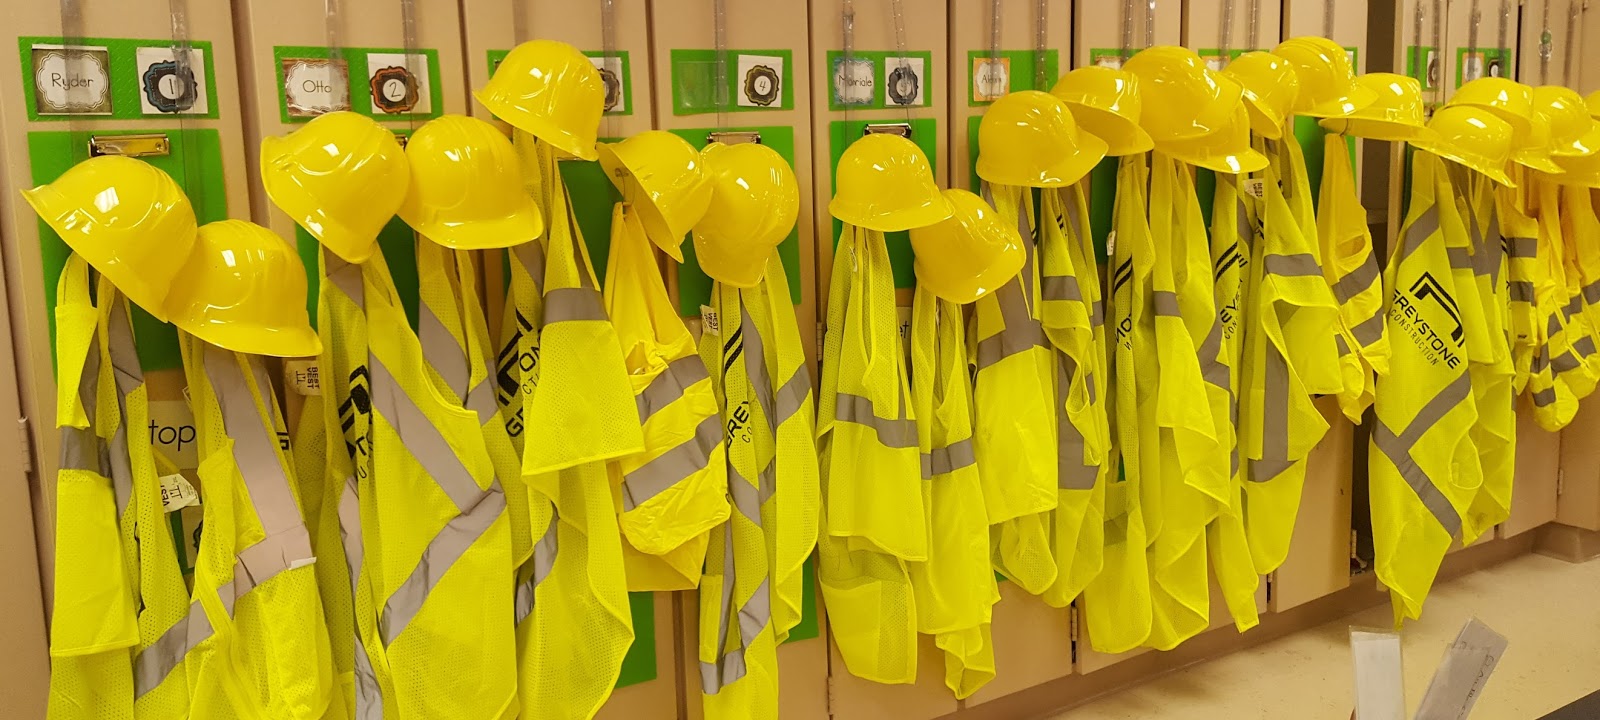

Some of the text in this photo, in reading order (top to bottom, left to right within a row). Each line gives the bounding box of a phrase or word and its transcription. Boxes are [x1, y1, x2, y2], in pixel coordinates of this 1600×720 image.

[51, 72, 94, 91] Ryder
[168, 78, 174, 95] 1
[302, 79, 332, 93] Otto
[388, 81, 401, 98] 2
[759, 80, 767, 91] 4
[1389, 308, 1440, 366] CONSTRUCTION
[306, 367, 314, 389] VEST
[311, 366, 320, 389] BEST
